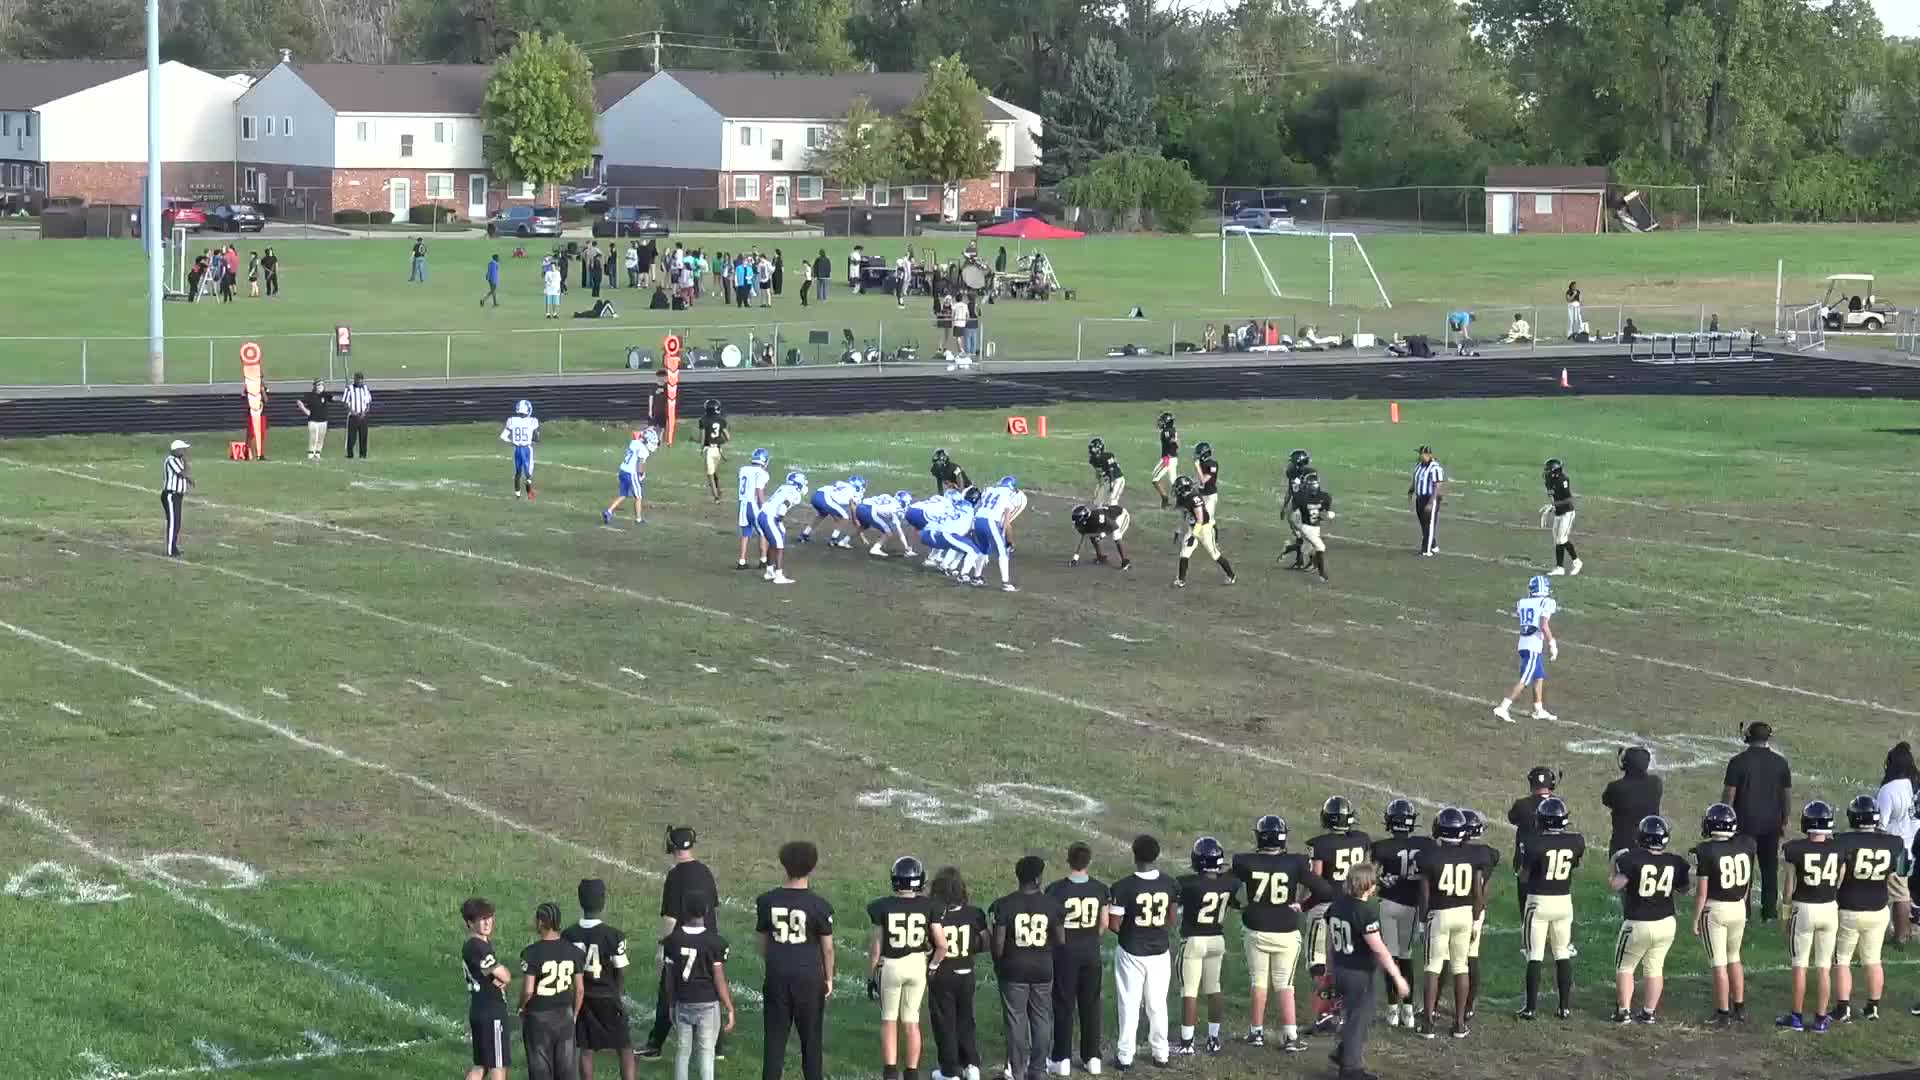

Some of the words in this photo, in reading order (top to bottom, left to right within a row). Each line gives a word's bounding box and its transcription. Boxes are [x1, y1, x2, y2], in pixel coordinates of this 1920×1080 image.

[515, 427, 528, 441] 85
[711, 423, 720, 438] 3
[1012, 419, 1027, 433] G
[1438, 863, 1473, 897] 40
[1545, 849, 1573, 880] 16
[1638, 864, 1675, 897] 64
[1719, 852, 1751, 889] 80
[1803, 853, 1838, 886] 54
[1853, 848, 1891, 881] 62
[1252, 872, 1288, 904] 76
[1063, 897, 1099, 928] 20
[1135, 892, 1169, 926] 33
[1197, 892, 1230, 923] 21
[771, 907, 807, 944] 59
[888, 912, 926, 948] 56
[1014, 913, 1049, 947] 68
[537, 960, 574, 996] 28
[680, 947, 697, 981] 7
